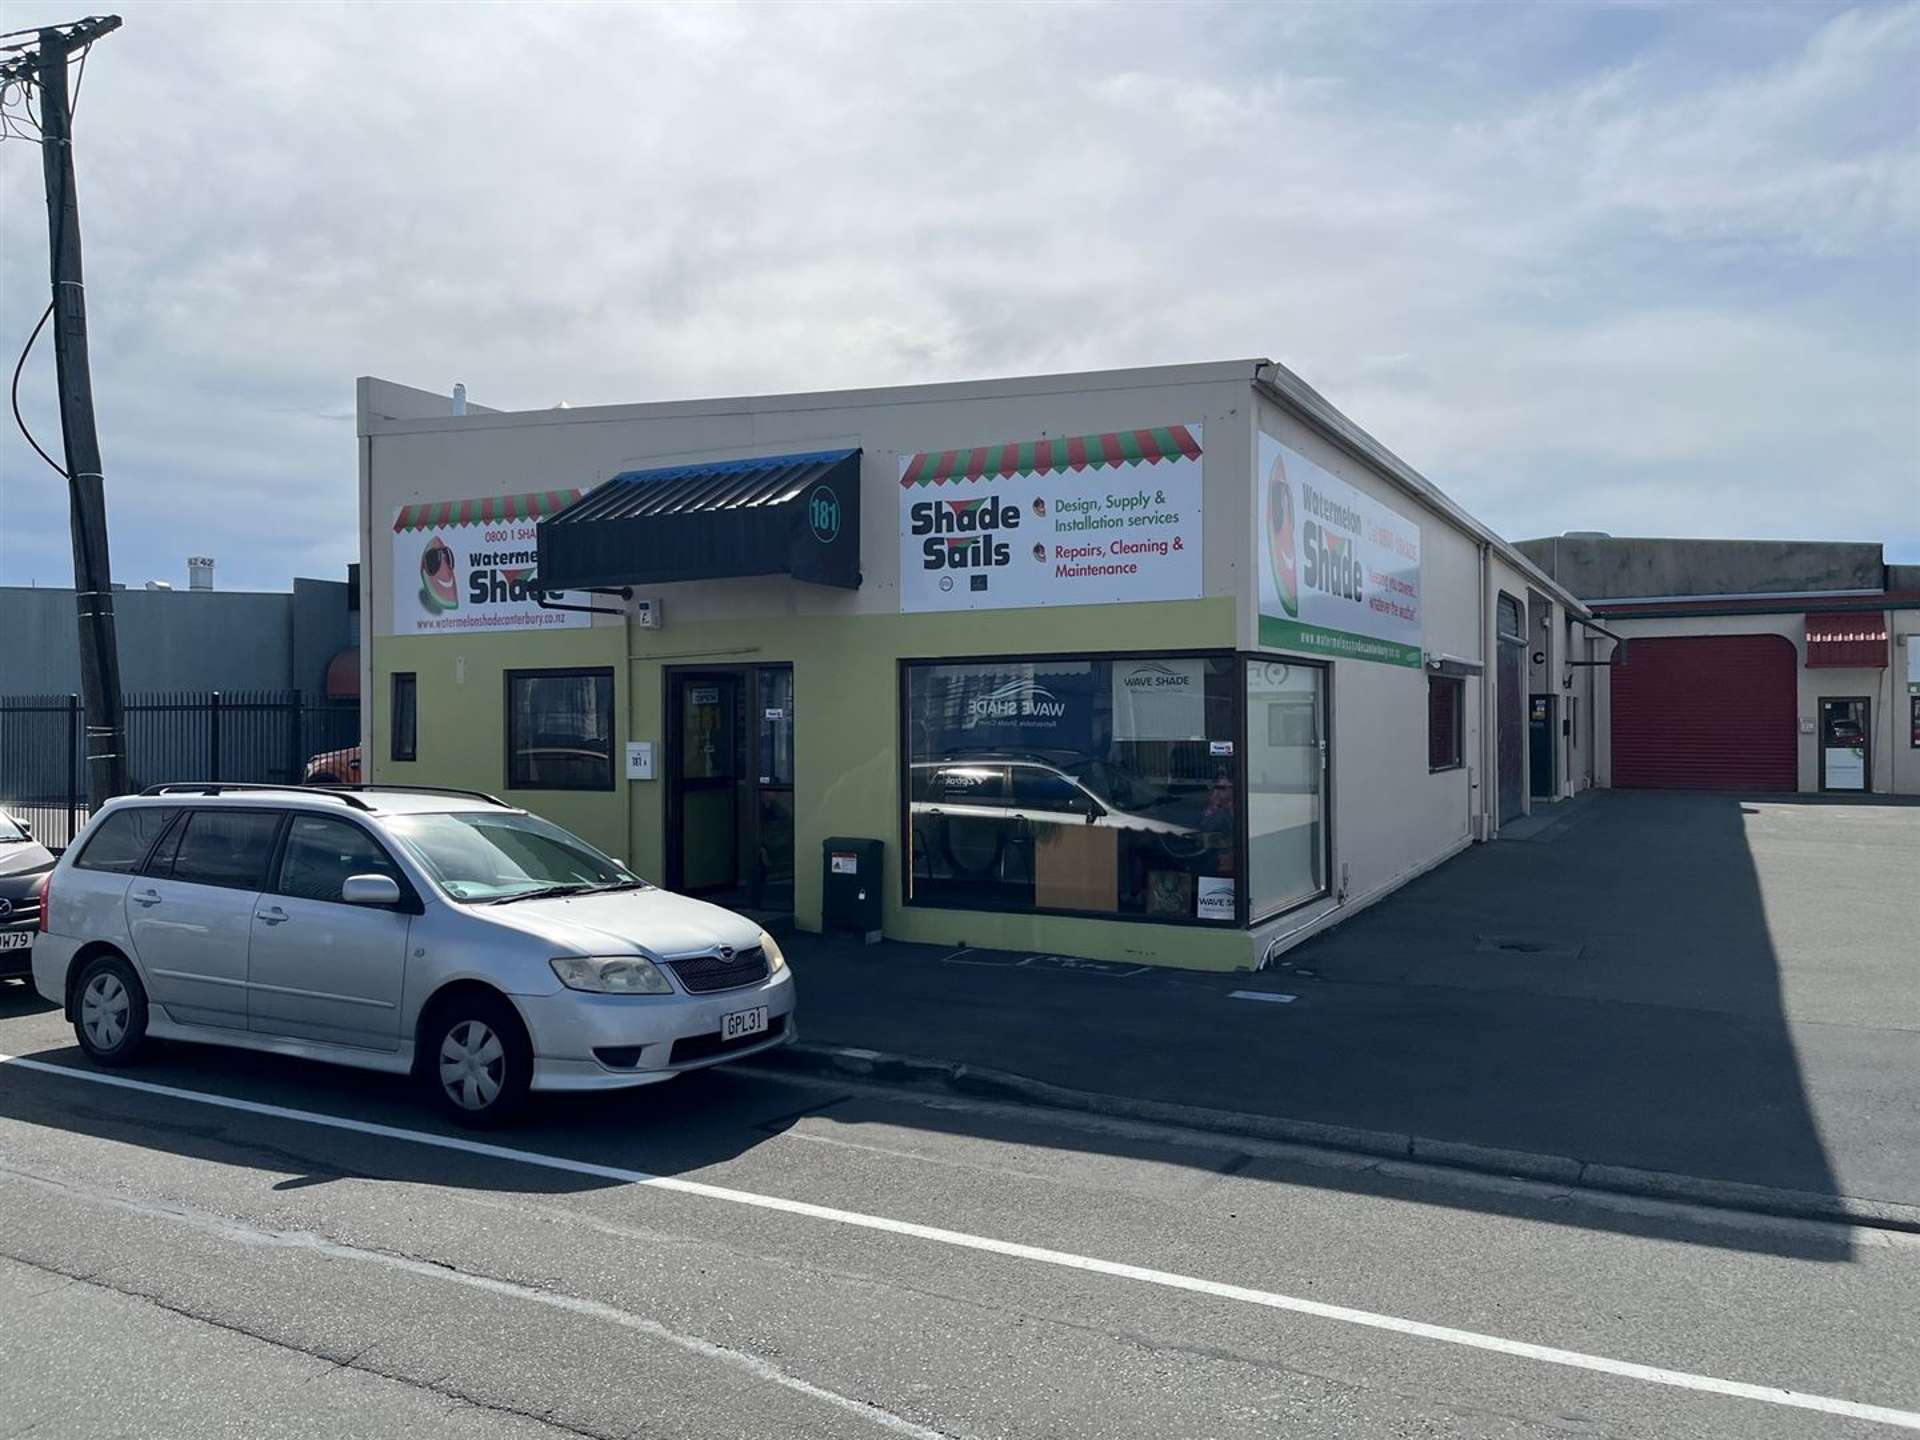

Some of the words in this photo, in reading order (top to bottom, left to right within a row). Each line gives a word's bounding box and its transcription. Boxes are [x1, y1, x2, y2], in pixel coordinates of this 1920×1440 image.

[1055, 497, 1102, 515] Design,
[1105, 490, 1151, 511] Supply
[1154, 489, 1166, 505] &
[1302, 482, 1362, 536] Watermelon
[812, 499, 836, 531] 181
[911, 496, 1020, 535] Shade
[1055, 515, 1124, 532] Installation
[1128, 510, 1180, 526] services
[485, 529, 508, 543] 0800
[517, 527, 538, 540] SHA
[469, 550, 537, 567] Waterme
[923, 535, 1010, 570] Sails
[1055, 543, 1106, 562] Repairs,
[1110, 539, 1169, 556] Cleaning
[1172, 536, 1184, 551] &
[1303, 519, 1363, 602] Shade
[1055, 563, 1138, 579] Maintenance
[1533, 651, 1545, 665] C
[1124, 677, 1152, 687] WAVE
[1154, 675, 1190, 686] SHADE
[1200, 897, 1225, 907] WAVE
[0, 933, 28, 949] W79
[728, 1012, 761, 1036] GPL31
